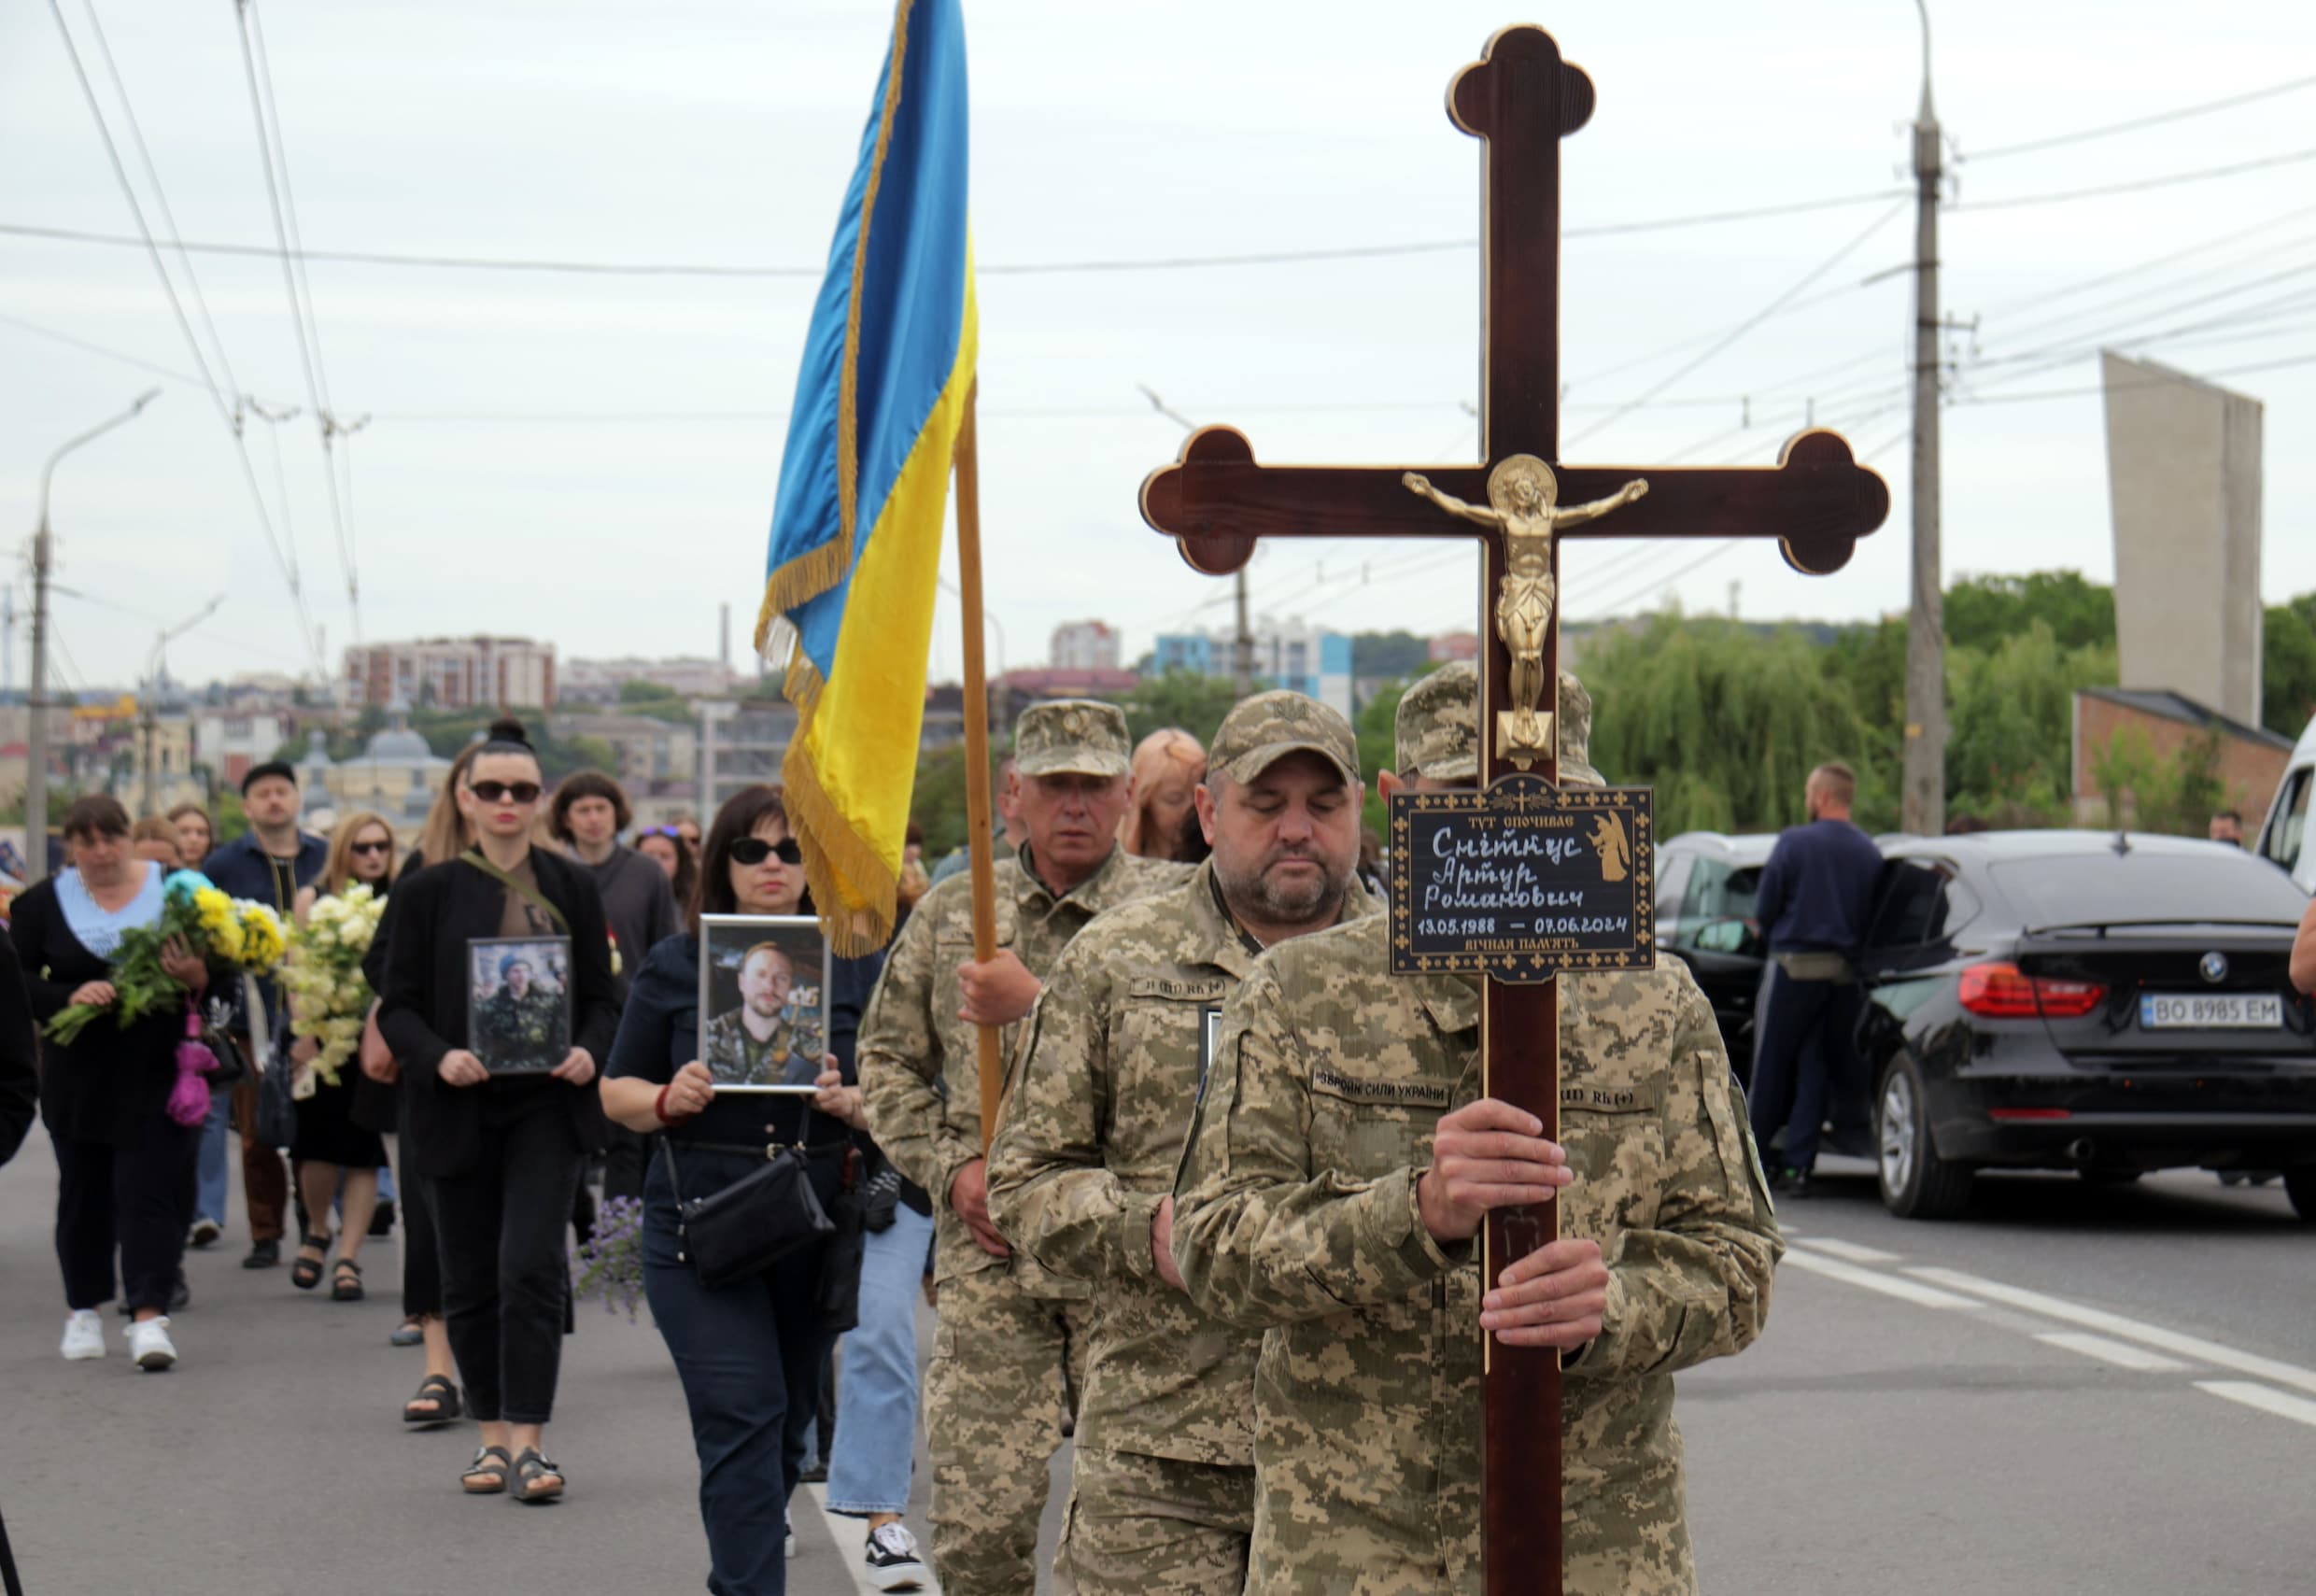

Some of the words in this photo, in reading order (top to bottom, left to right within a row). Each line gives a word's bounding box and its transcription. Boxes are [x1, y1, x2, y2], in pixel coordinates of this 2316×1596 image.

[1467, 815, 1496, 831] ТУТ
[1432, 855, 1537, 897] Артур
[1424, 884, 1583, 911] Романович
[1418, 917, 1496, 936] 13.05.1988
[1534, 916, 1628, 934] 07.06.2024
[2194, 999, 2241, 1021] 8985
[2246, 999, 2278, 1023] EM
[1365, 1082, 1396, 1099] СИЛИ
[1398, 1083, 1445, 1101] УКРАЇНИ
[1592, 1090, 1611, 1105] Rh
